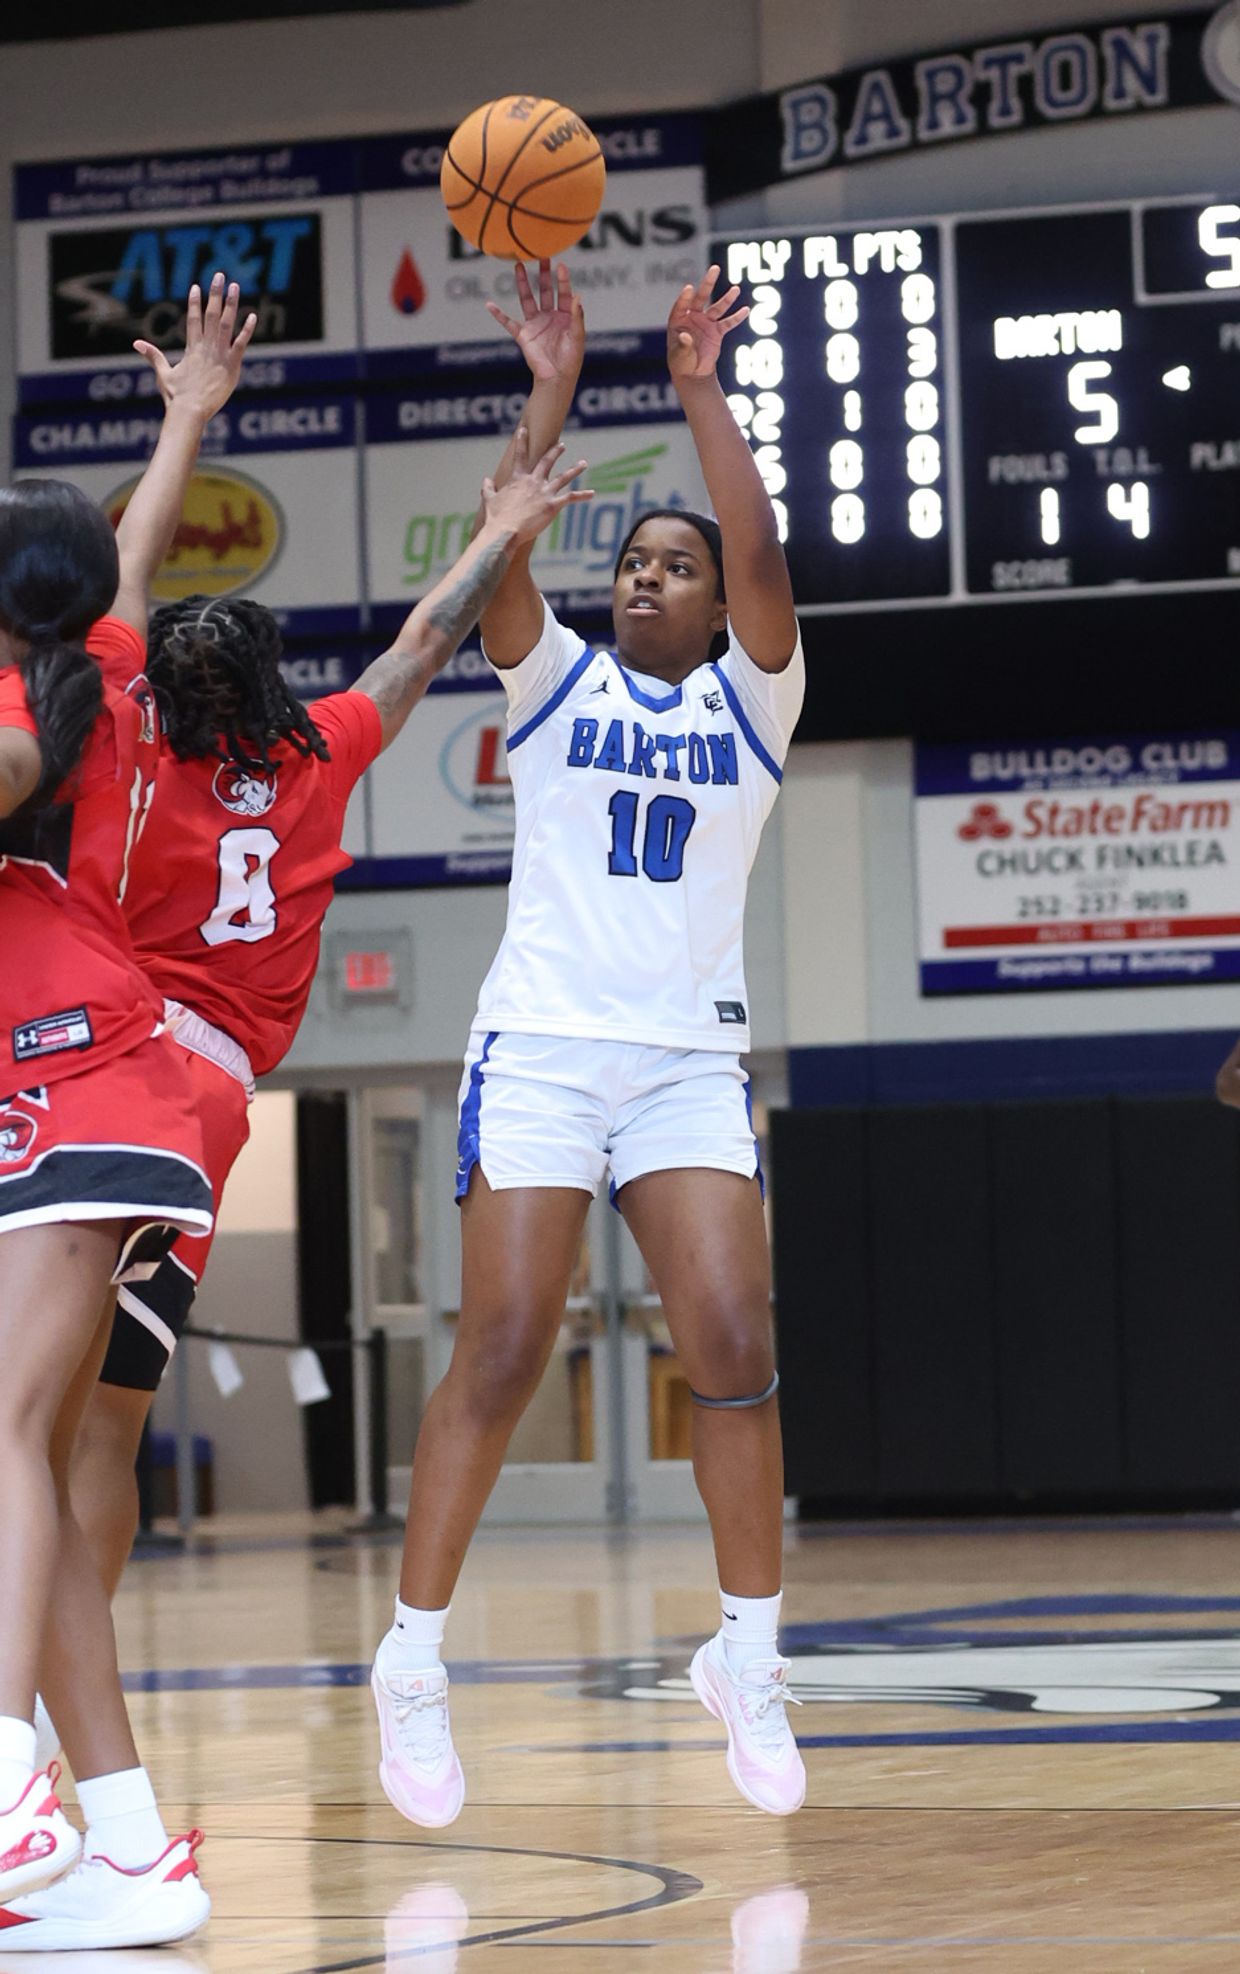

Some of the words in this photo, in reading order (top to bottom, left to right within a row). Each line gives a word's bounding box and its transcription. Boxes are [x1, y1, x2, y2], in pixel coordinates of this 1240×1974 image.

[779, 22, 1169, 173] BARTON
[109, 216, 314, 306] AT&T
[853, 229, 922, 275] PTS
[748, 285, 782, 336] 2
[907, 327, 937, 378] 3
[88, 372, 132, 400] GO
[579, 380, 680, 414] CIRCLE
[1067, 360, 1119, 444] 5
[239, 405, 341, 439] CIRCLE
[988, 451, 1070, 485] FOULS
[1040, 487, 1060, 545] 1
[1107, 481, 1150, 539] 4
[991, 558, 1073, 590] SCORE
[566, 717, 739, 786] BARTON
[968, 744, 1132, 782] BULLDOG
[1140, 739, 1229, 773] CLUB
[606, 789, 697, 883] 10
[975, 845, 1085, 878] CHUCK
[1095, 838, 1227, 869] FINKLEA
